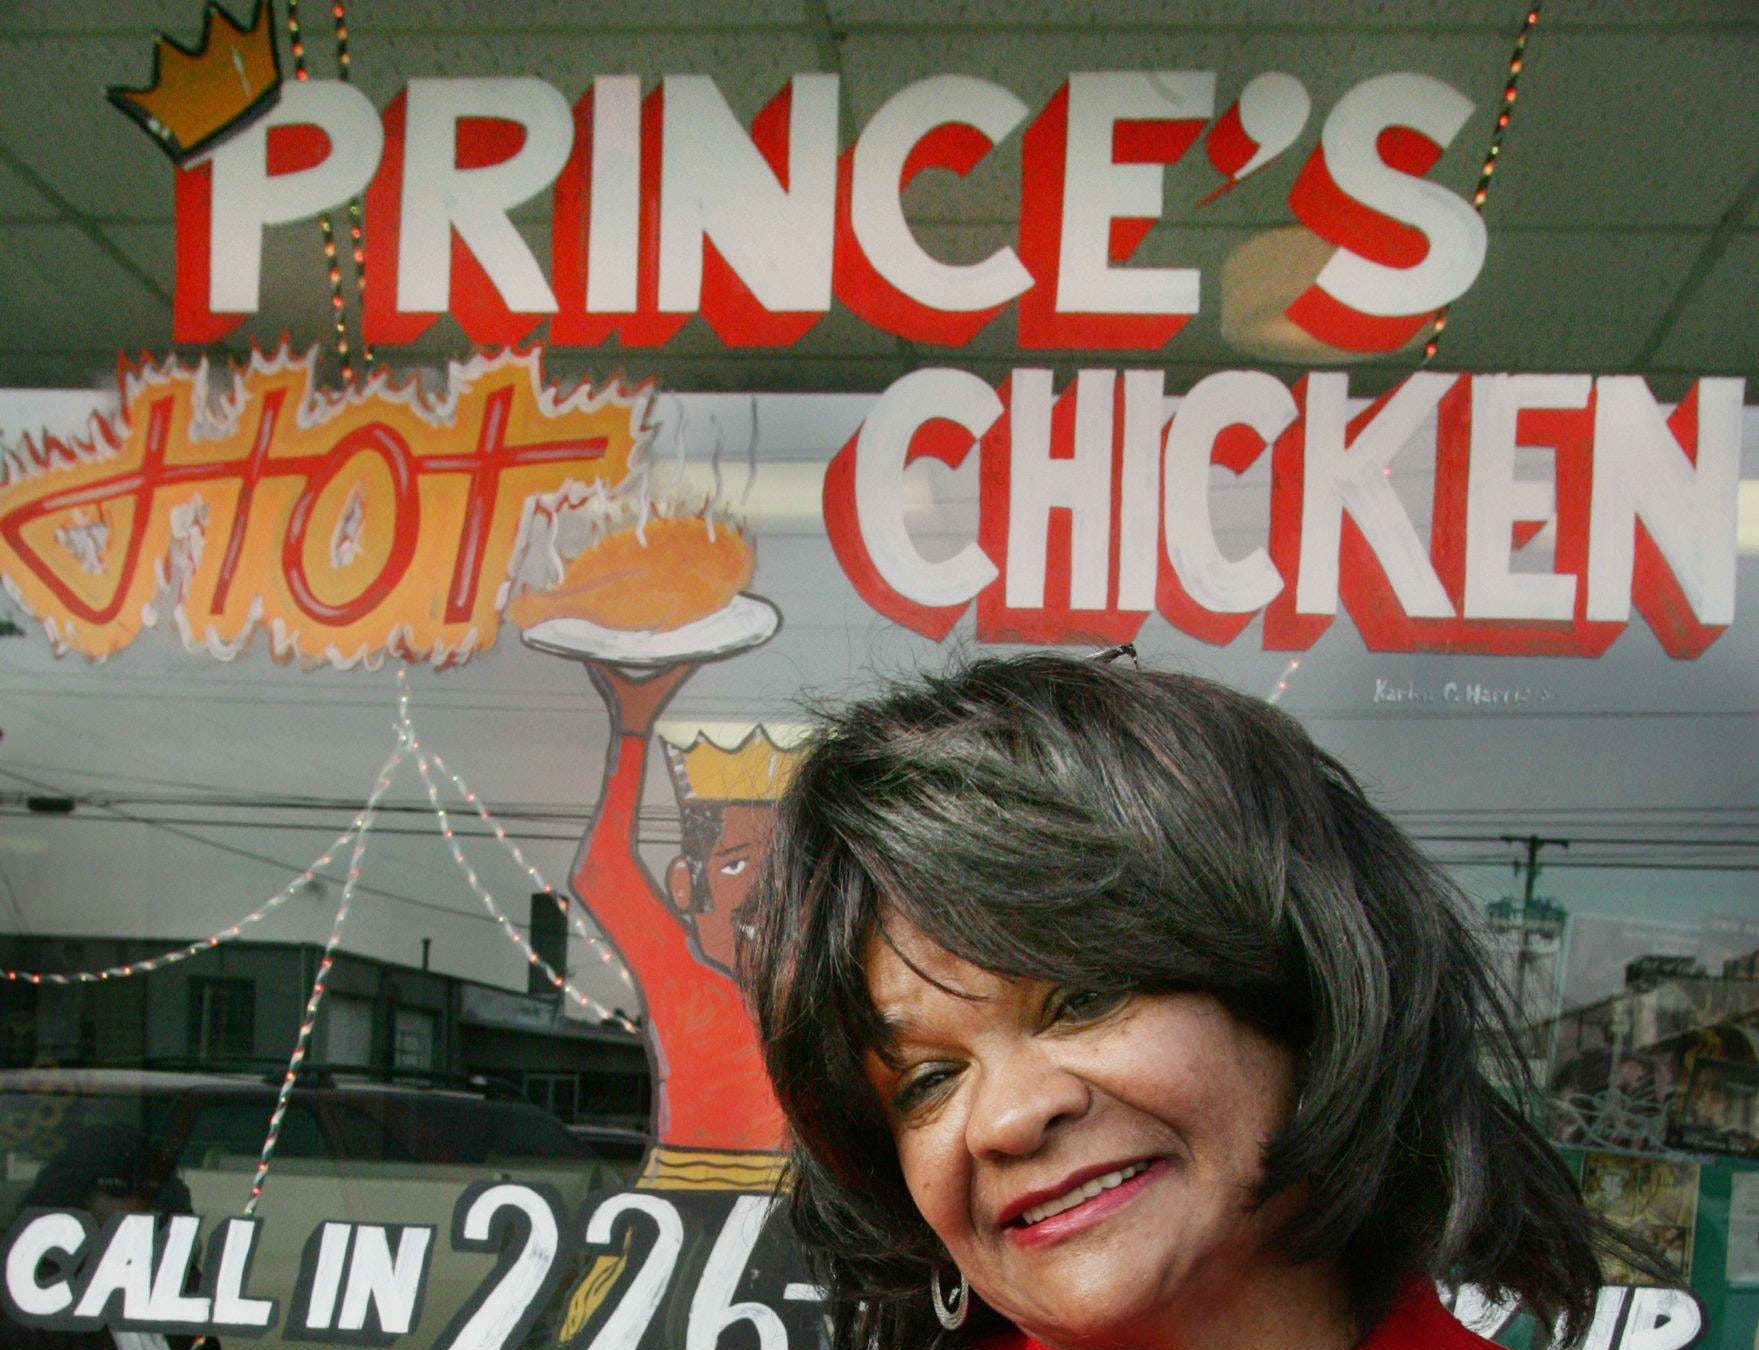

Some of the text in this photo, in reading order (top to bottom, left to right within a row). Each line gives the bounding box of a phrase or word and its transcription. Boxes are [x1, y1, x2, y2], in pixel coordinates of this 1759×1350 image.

[206, 72, 1488, 316] PRINCE'S
[853, 367, 1745, 625] CHICKEN
[4, 1213, 273, 1325] CALL
[307, 1222, 431, 1334] IN
